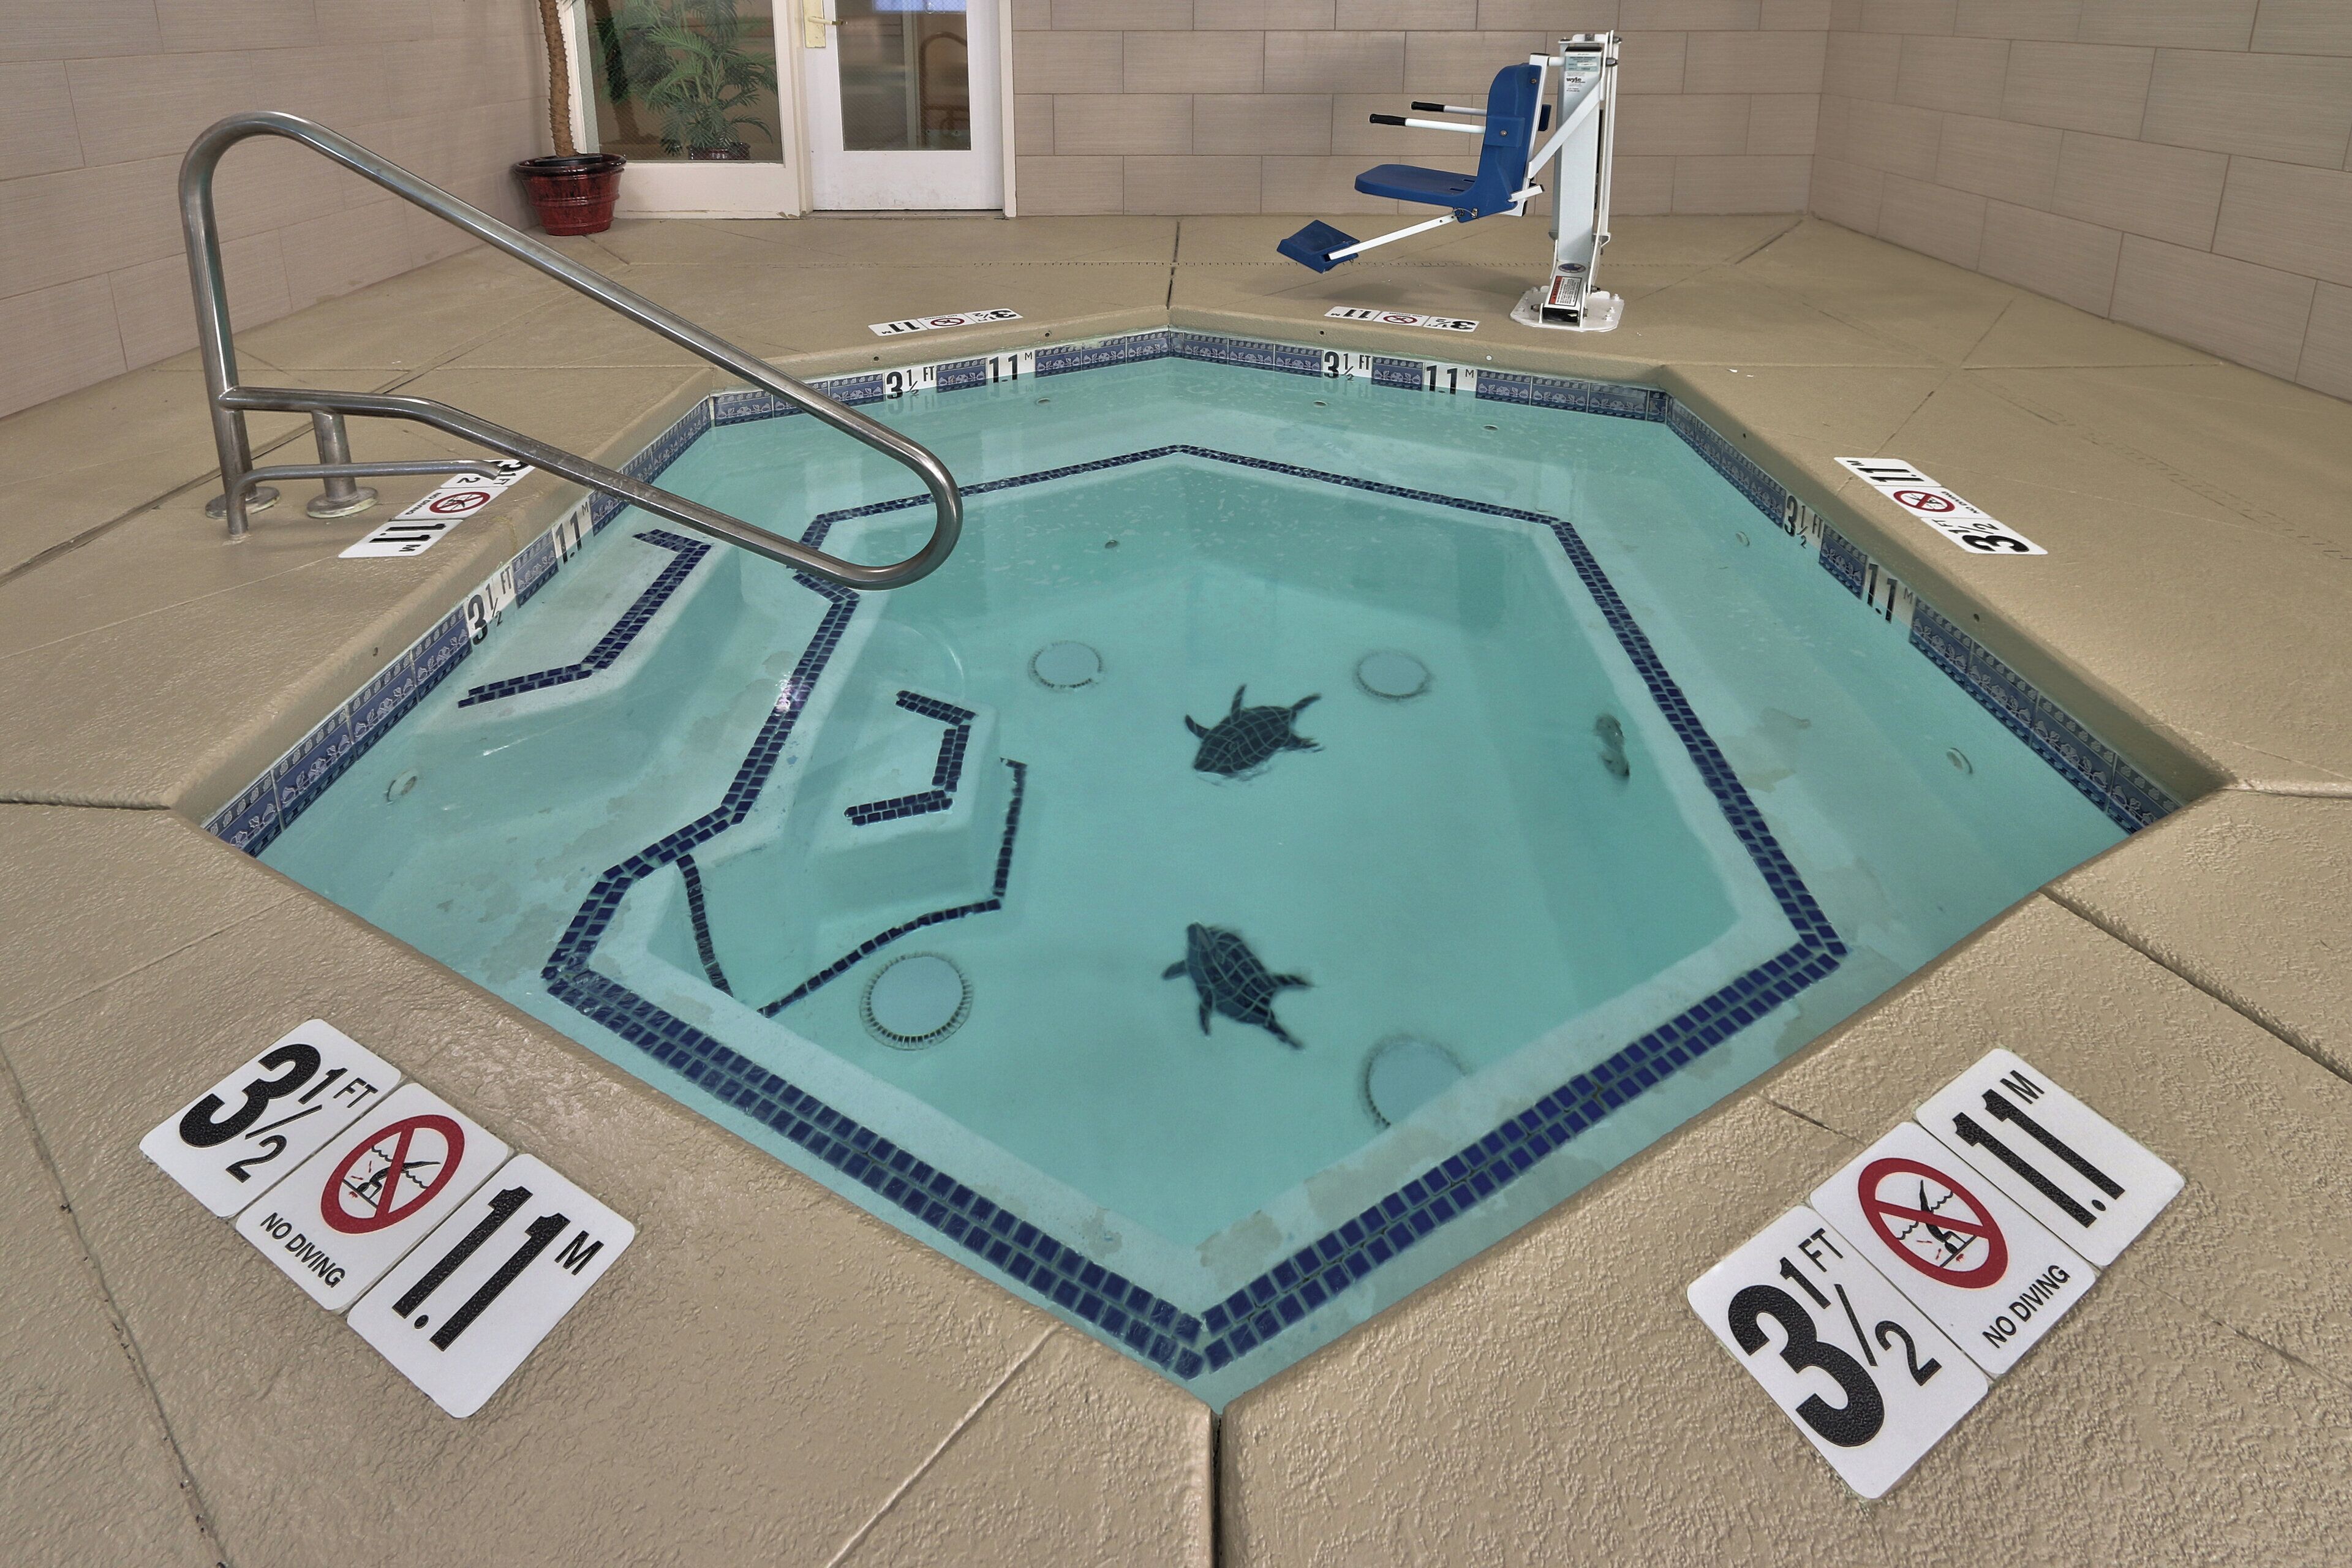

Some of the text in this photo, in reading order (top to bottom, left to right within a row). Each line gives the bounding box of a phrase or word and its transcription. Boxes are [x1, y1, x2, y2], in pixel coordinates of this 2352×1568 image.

[923, 366, 935, 382] FT
[989, 352, 1033, 383] 1.1 M
[1359, 355, 1371, 370] FT
[1427, 365, 1474, 395] 1.1 M
[1857, 467, 1924, 483] 1.1
[405, 500, 431, 515] DIVING
[1941, 491, 1967, 507] DIVING
[556, 502, 589, 565] 1.1 M
[1812, 514, 1825, 539] FT
[1932, 518, 1954, 527] FT
[369, 524, 447, 552] 1.1 M
[499, 565, 511, 595] FT
[1867, 564, 1913, 624] 1.1 M
[333, 1077, 378, 1108] FT
[1952, 1070, 2125, 1228] 1.1 M
[260, 1213, 345, 1288] NO DIVING
[1799, 1228, 1845, 1272] FT
[392, 1186, 604, 1351] 1.1 M
[1982, 1265, 2071, 1348] NO DIVING
